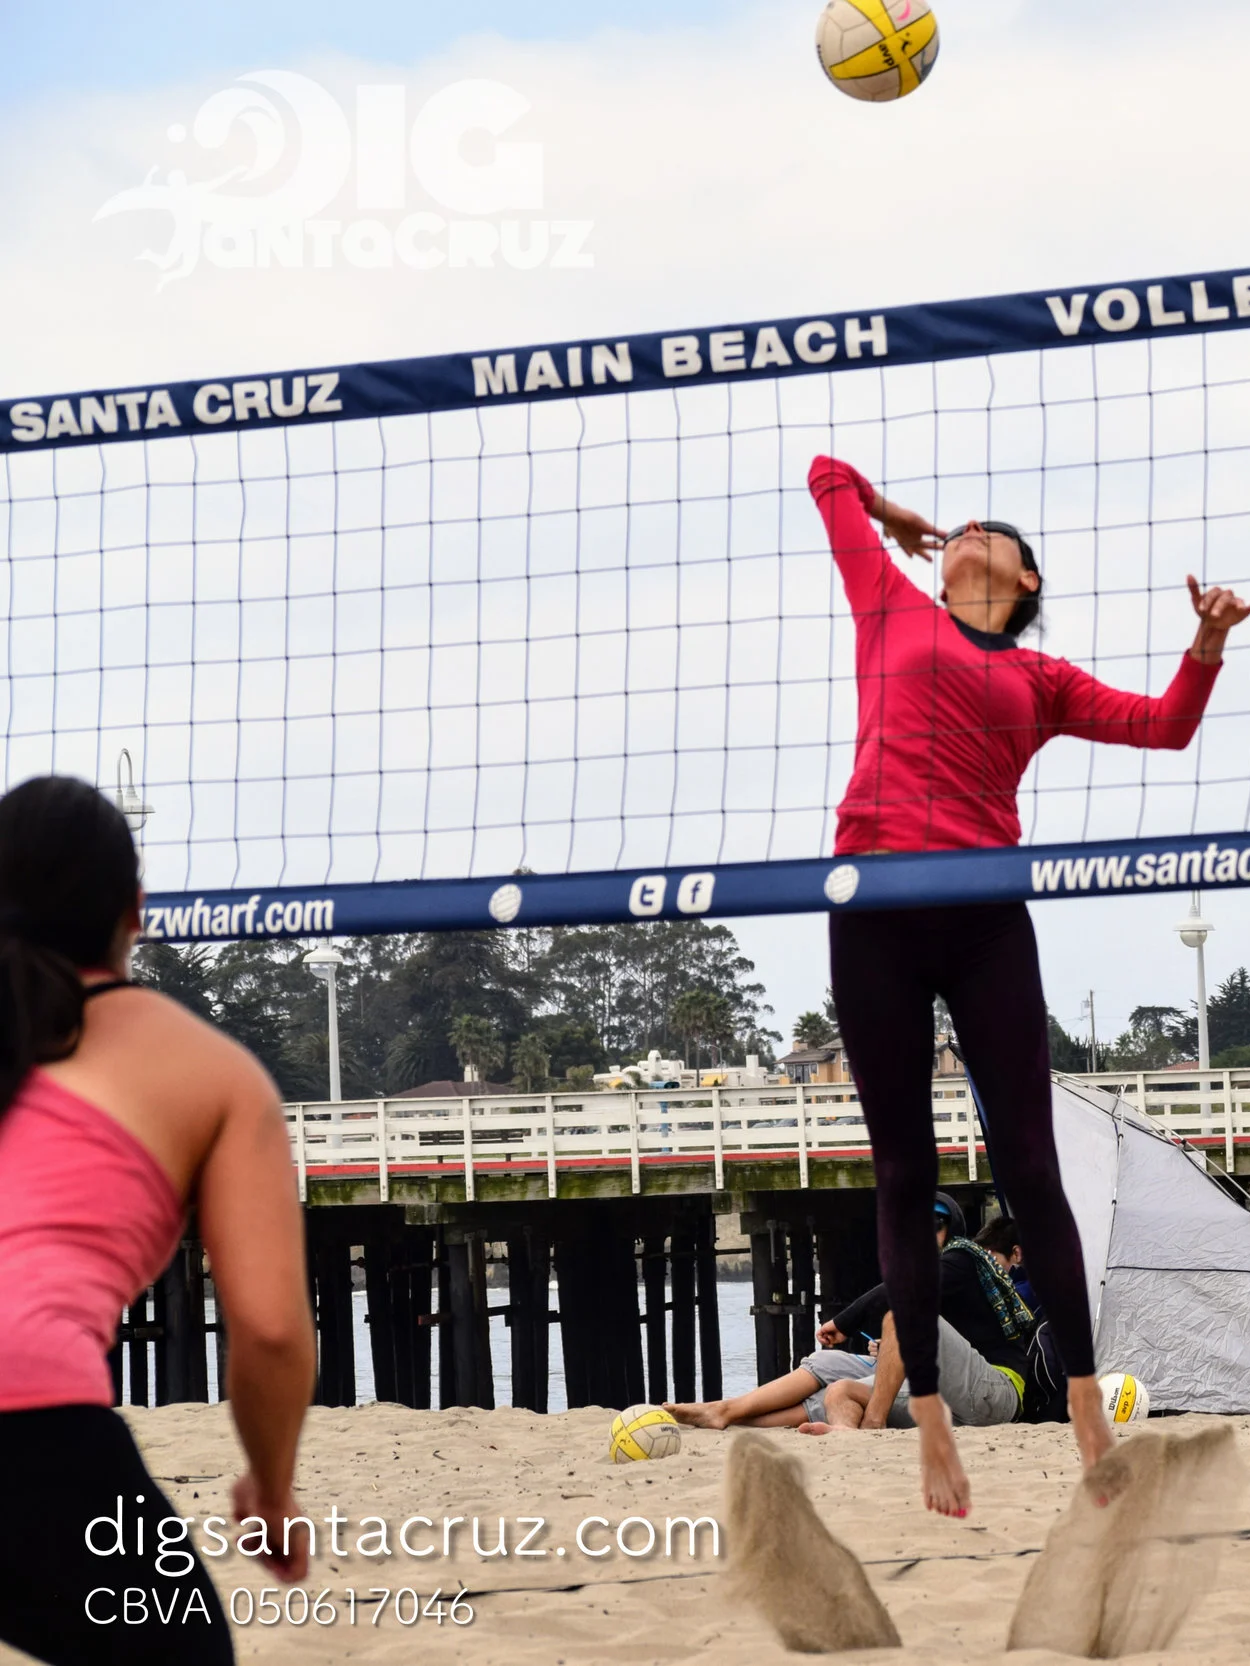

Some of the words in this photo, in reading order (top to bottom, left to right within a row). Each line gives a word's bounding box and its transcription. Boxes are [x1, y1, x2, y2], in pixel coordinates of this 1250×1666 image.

[471, 342, 633, 397] MAIN
[661, 315, 888, 377] BEACH
[10, 389, 181, 442] SANTA
[193, 373, 342, 424] CRUZ
